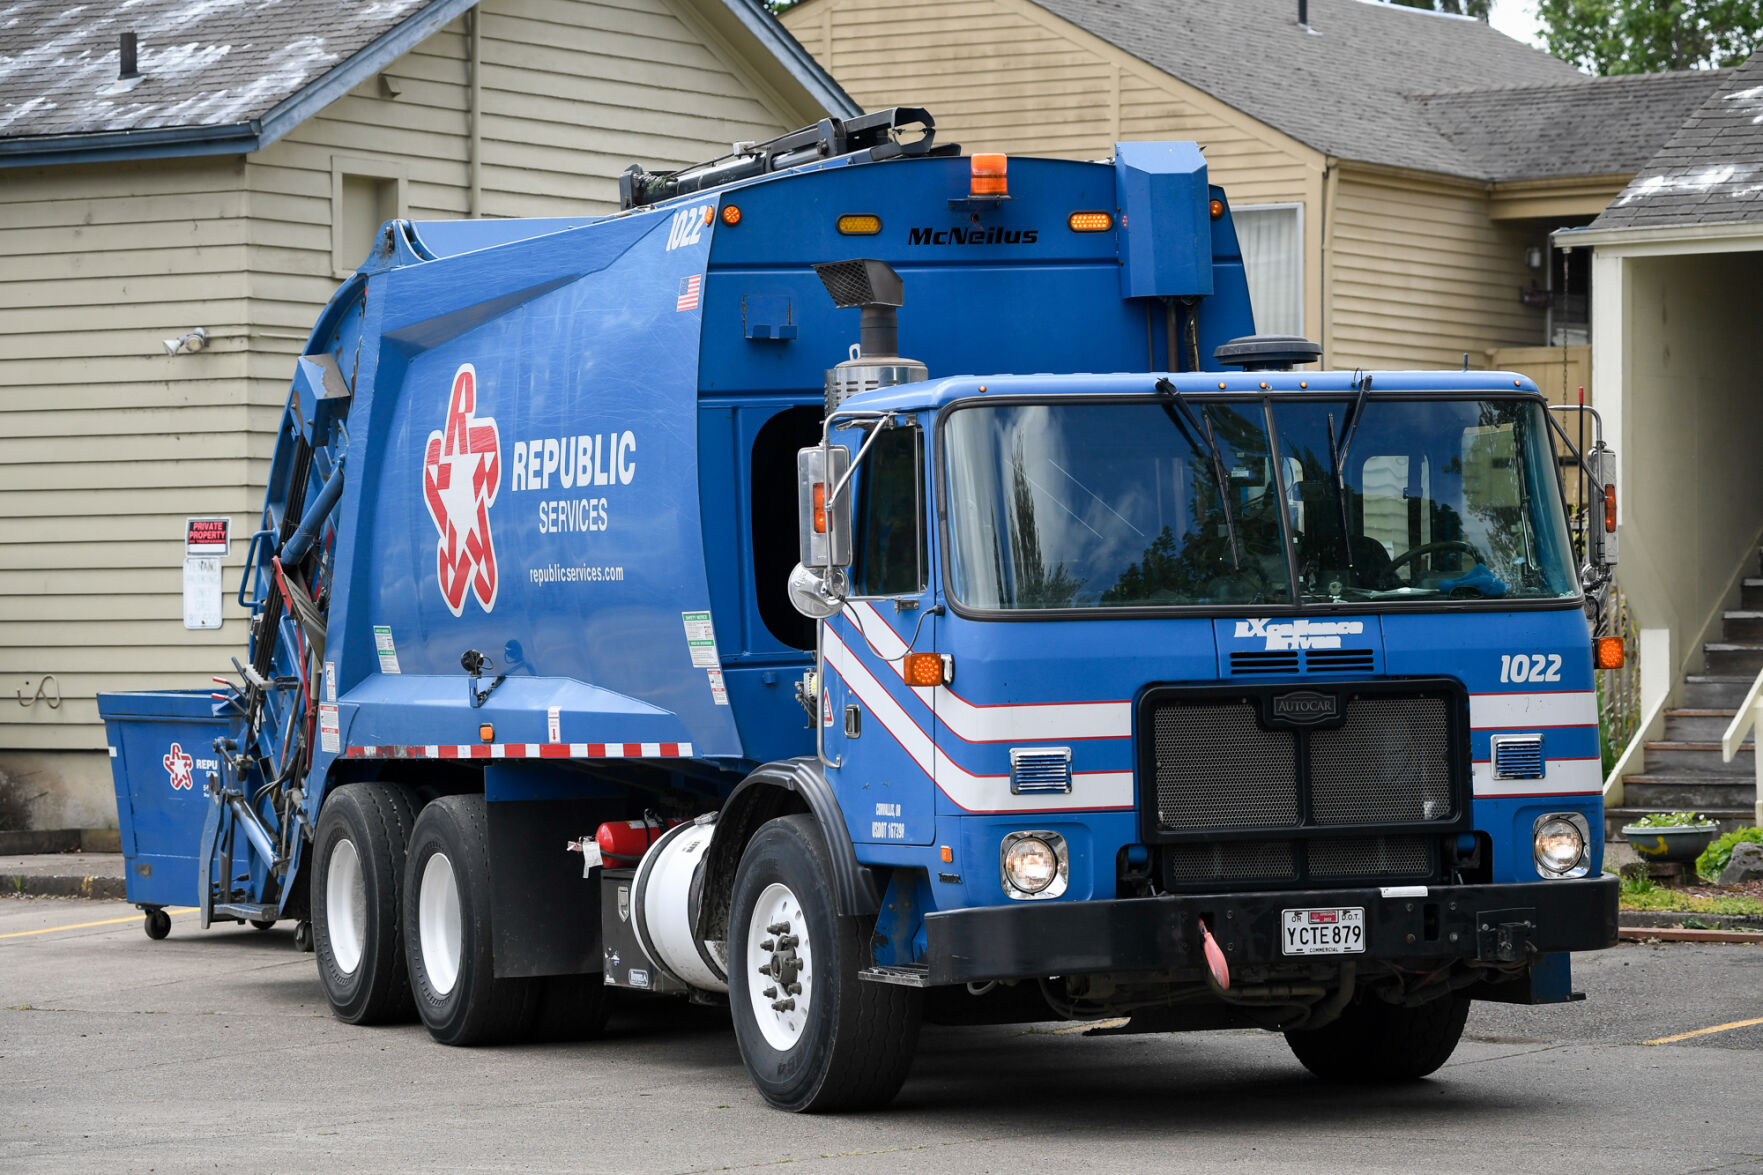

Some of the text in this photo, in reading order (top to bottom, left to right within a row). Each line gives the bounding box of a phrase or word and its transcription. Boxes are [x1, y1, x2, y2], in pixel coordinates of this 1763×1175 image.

[666, 205, 707, 251] 1022
[908, 227, 1039, 245] McNeilus
[512, 430, 636, 491] REPUBLIC
[539, 497, 608, 534] SERVICES
[189, 531, 226, 539] PROPERTY
[193, 522, 223, 530] PRIVATE
[529, 563, 624, 587] republicservices.com
[1500, 654, 1562, 683] 1022
[1278, 701, 1332, 712] AUTOCAR
[195, 759, 219, 770] REPU
[871, 821, 887, 839] USDOT
[1287, 926, 1361, 946] YCTE879
